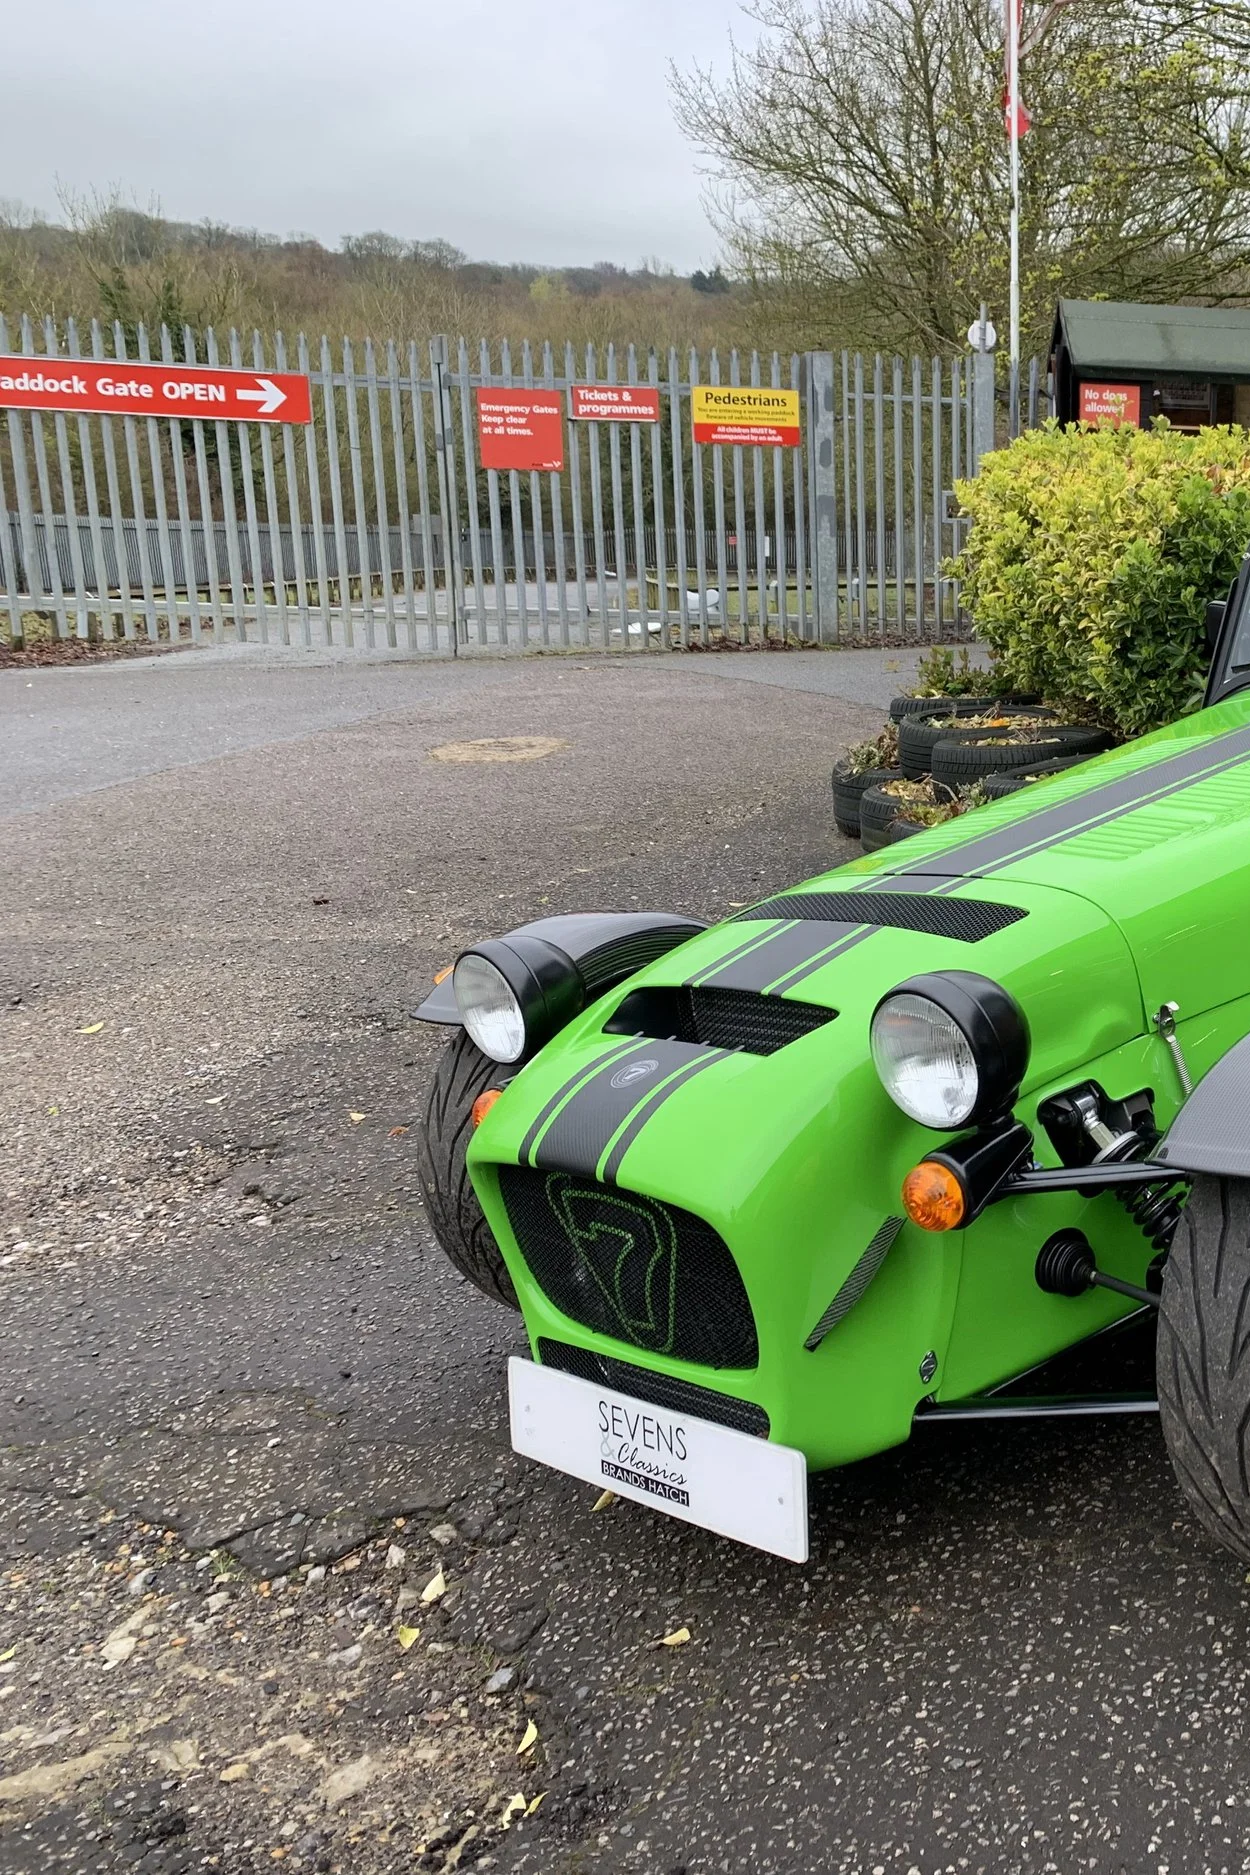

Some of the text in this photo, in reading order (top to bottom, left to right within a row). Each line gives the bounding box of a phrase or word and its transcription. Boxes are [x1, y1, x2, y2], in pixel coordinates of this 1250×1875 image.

[0, 372, 226, 402] addock Gate OPEN
[578, 389, 632, 402] Tickets &
[705, 392, 787, 407] Pedestrians
[1085, 389, 1099, 400] No
[480, 403, 558, 415] Emergency Gates
[578, 403, 654, 415] programmes
[482, 415, 527, 424] Keep clear
[494, 426, 504, 434] all
[507, 426, 533, 436] times.
[599, 1400, 687, 1461] SEVENS
[600, 1431, 688, 1485] & Classics
[602, 1462, 688, 1506] BRANDS HATCH
